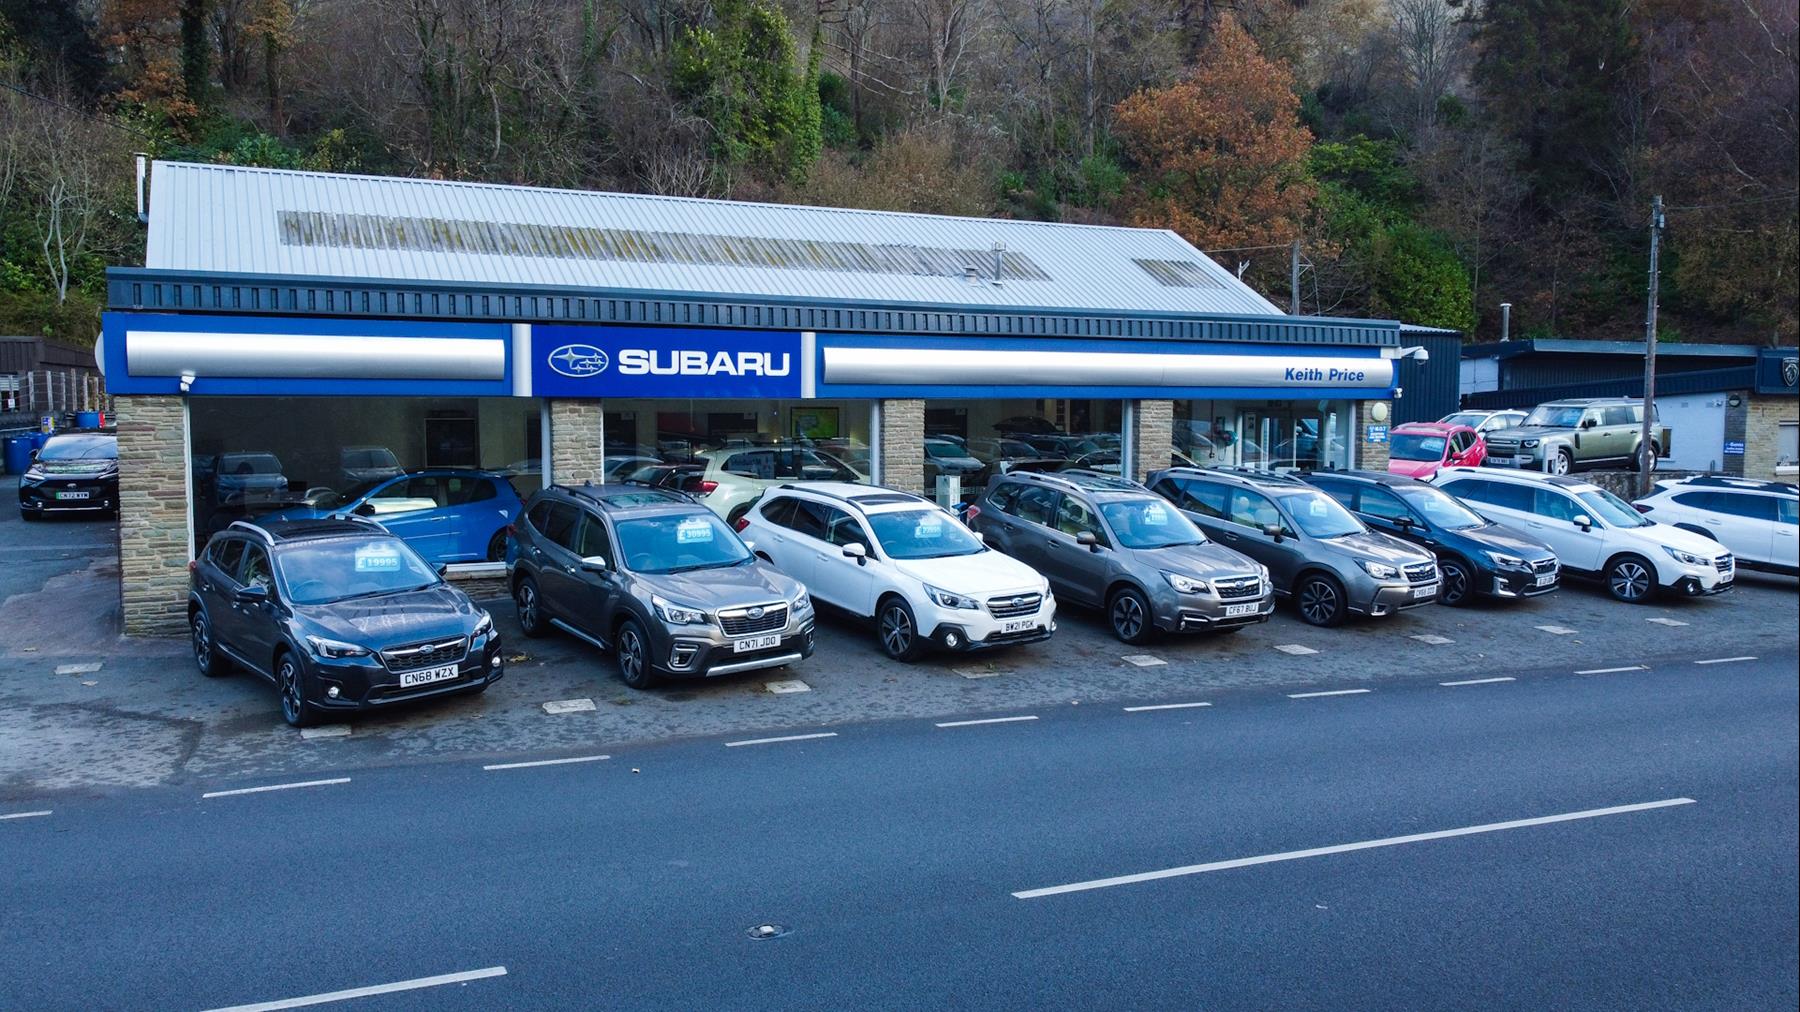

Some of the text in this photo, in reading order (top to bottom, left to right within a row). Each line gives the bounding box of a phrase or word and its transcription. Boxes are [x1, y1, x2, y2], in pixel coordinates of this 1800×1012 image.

[618, 349, 790, 376] SUBARU
[1285, 368, 1365, 381] Keith Price
[367, 557, 398, 568] 19995
[1228, 605, 1245, 615] CF67
[1005, 621, 1020, 632] BW21
[739, 639, 758, 650] CN71
[404, 667, 454, 685] CN68 WZX
